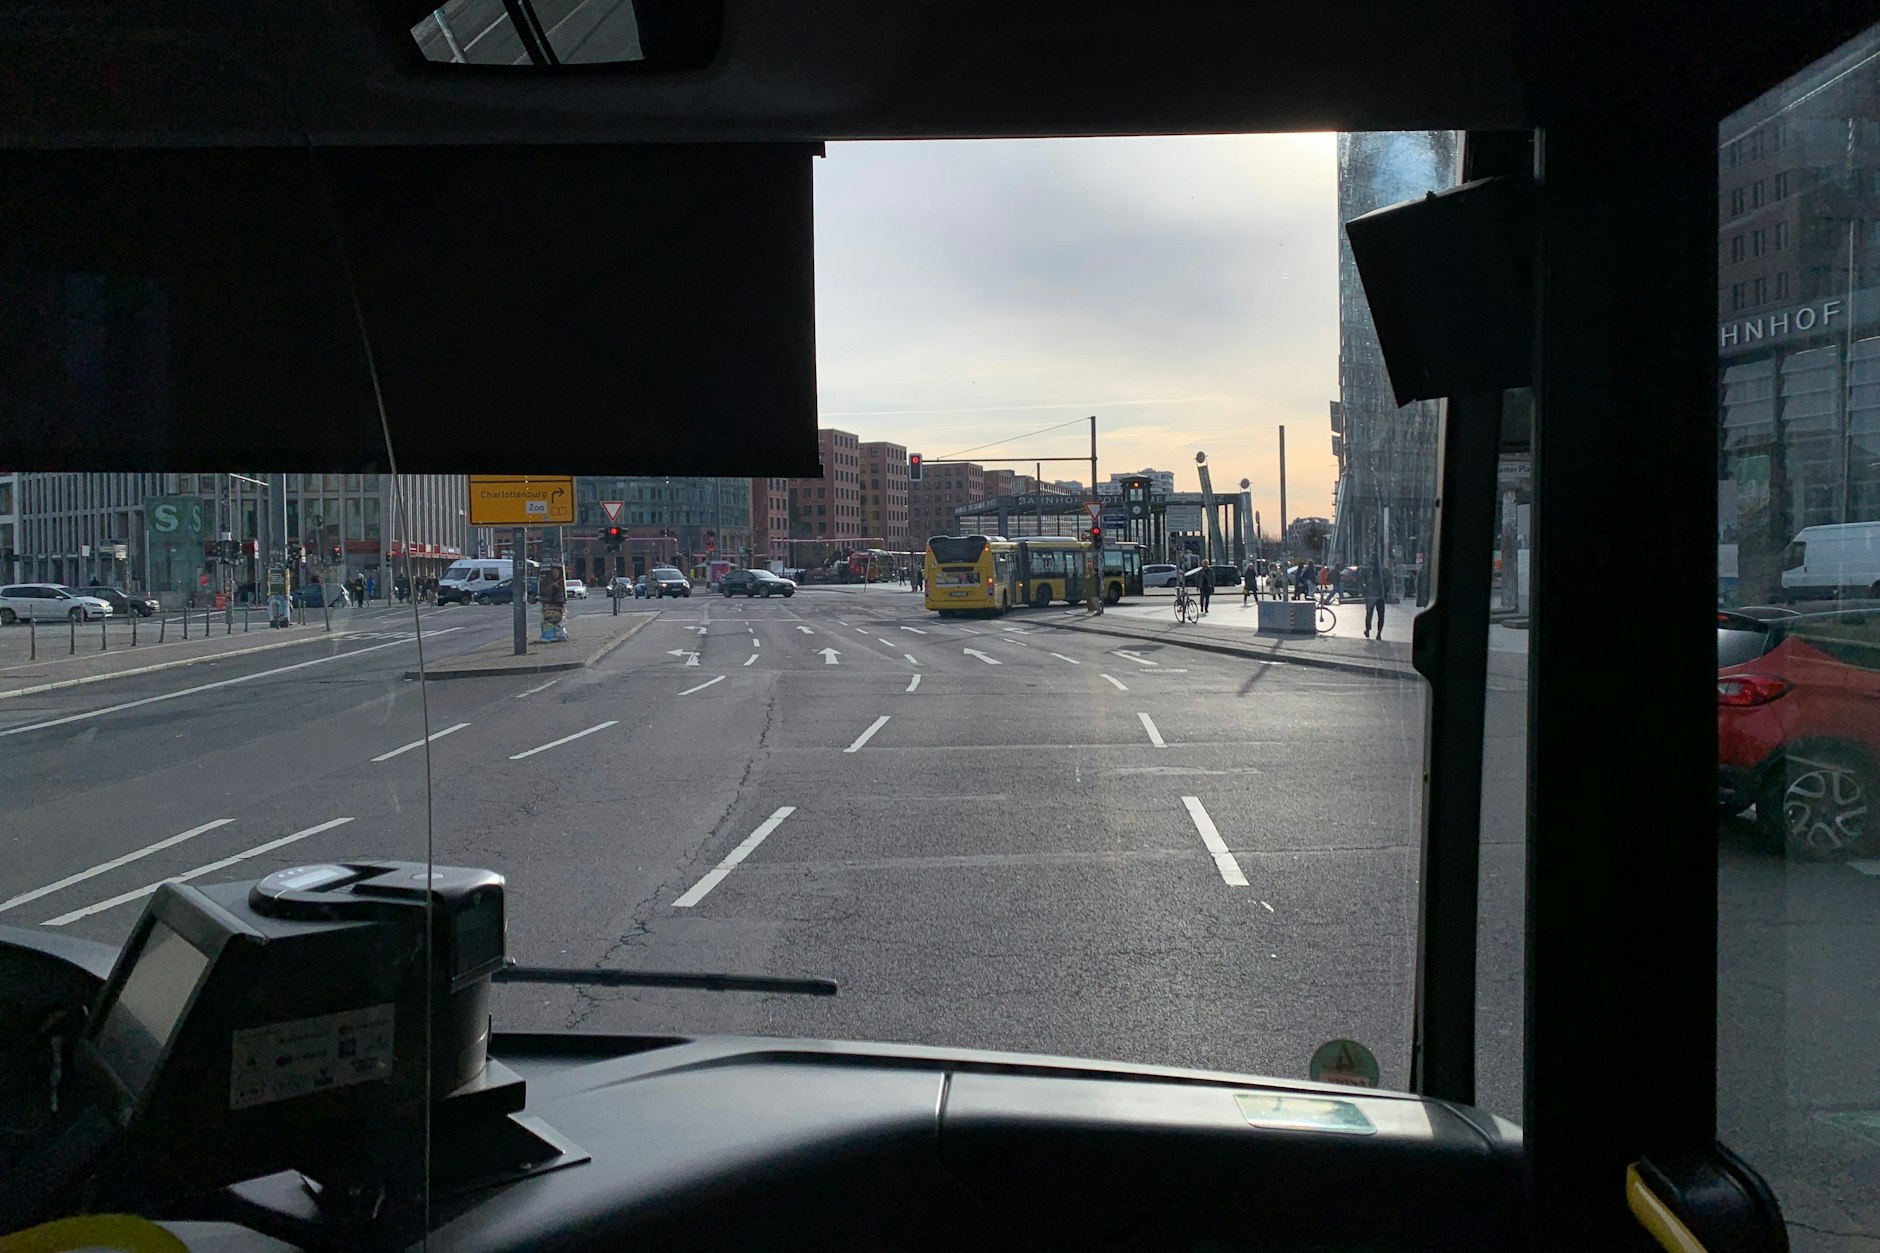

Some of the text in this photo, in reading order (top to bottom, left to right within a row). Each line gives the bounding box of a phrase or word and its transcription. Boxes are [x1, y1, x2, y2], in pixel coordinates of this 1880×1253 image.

[480, 490, 547, 499] Charlottenburg
[529, 503, 545, 511] Zoo
[155, 503, 179, 532] S
[192, 504, 201, 532] S
